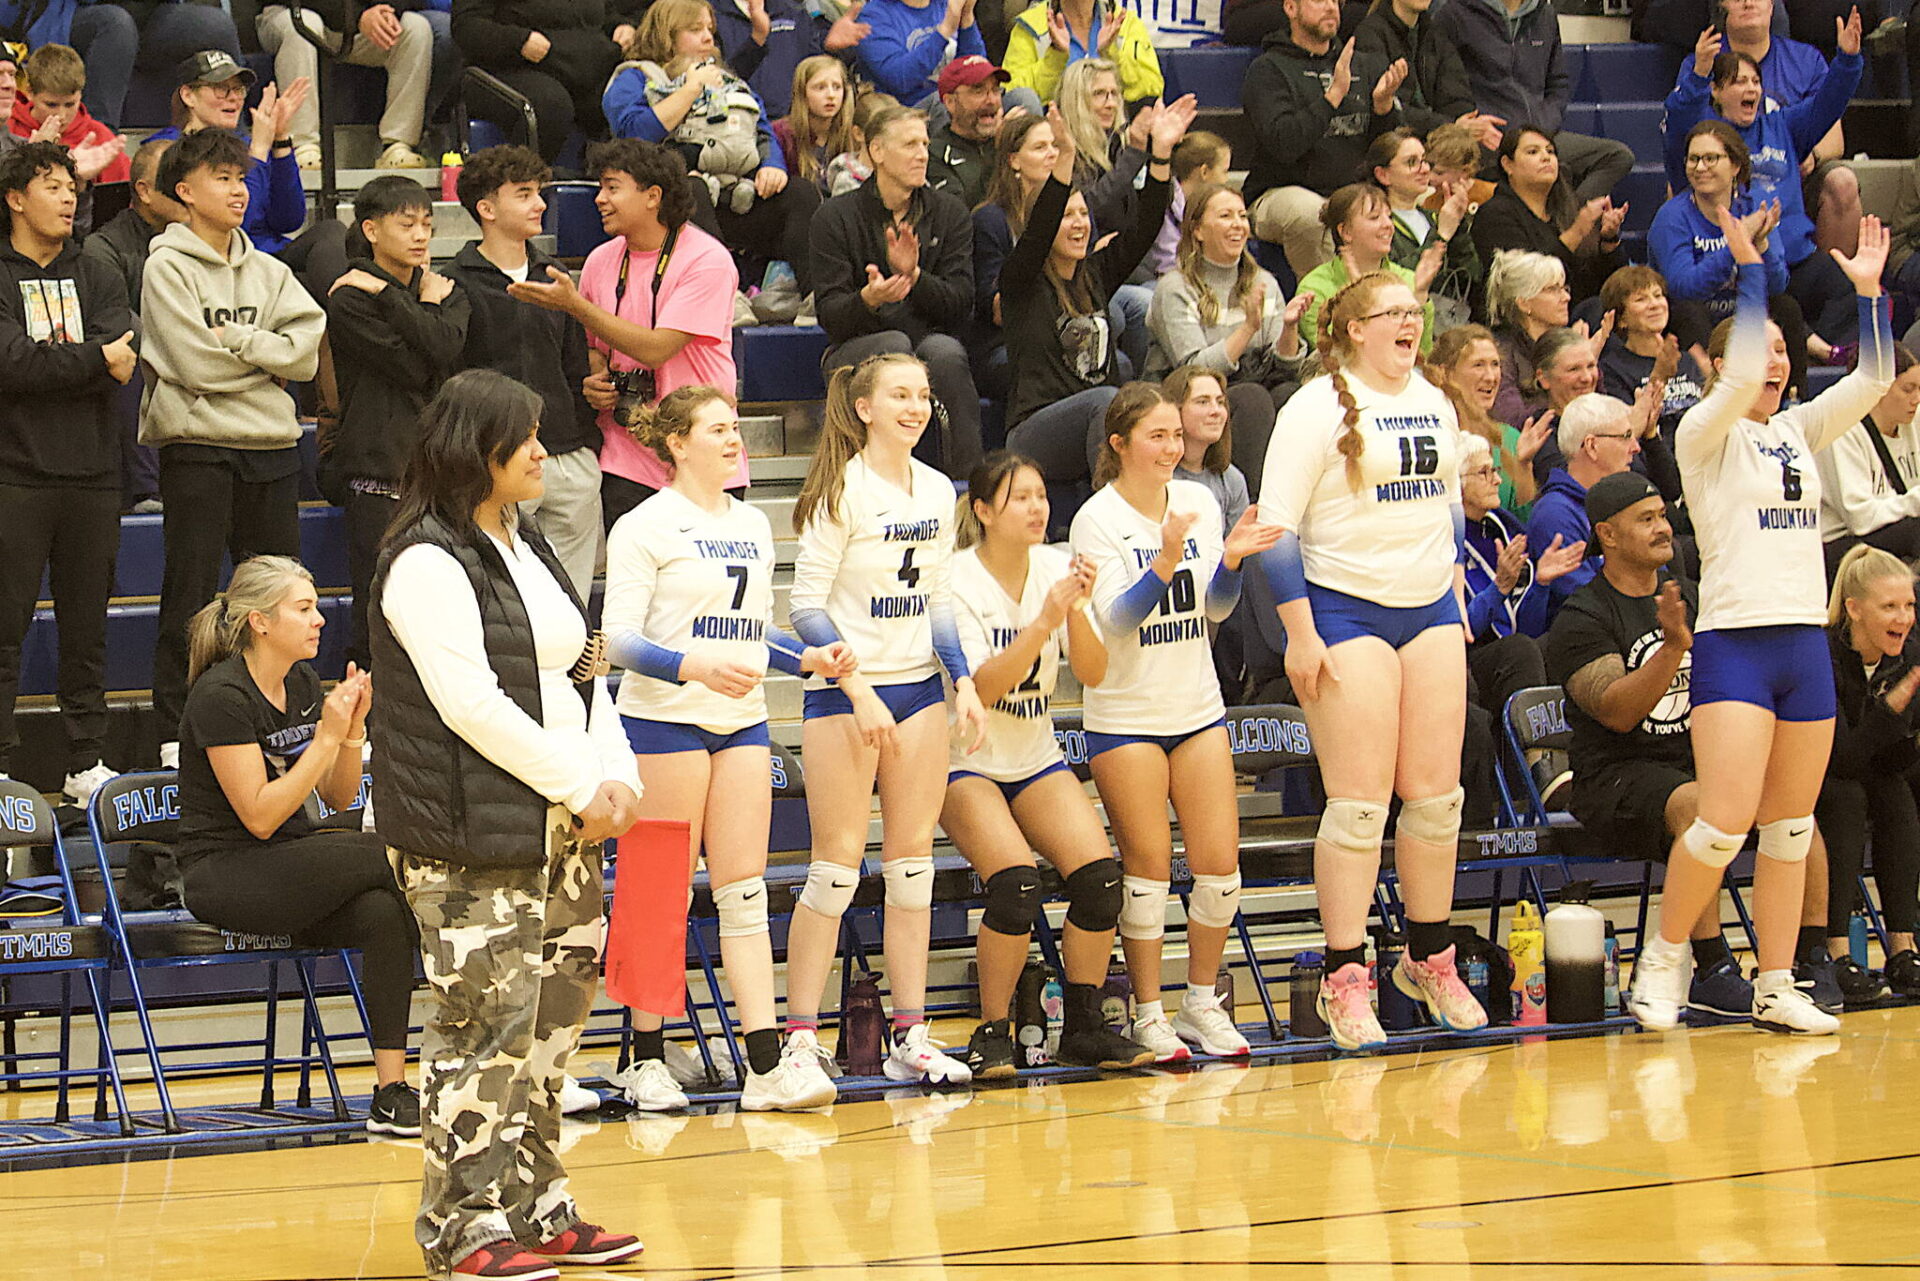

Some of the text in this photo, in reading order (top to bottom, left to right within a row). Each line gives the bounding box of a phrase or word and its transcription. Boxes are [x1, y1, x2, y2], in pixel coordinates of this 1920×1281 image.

[1399, 435, 1439, 477] 16
[1781, 460, 1803, 501] 6
[726, 565, 748, 610] 7
[897, 547, 920, 588] 4
[1160, 568, 1196, 616] 10
[1226, 717, 1311, 755] LCONS
[112, 785, 181, 832] FALC
[1476, 831, 1537, 856] TMHS
[0, 933, 72, 959] TMHS
